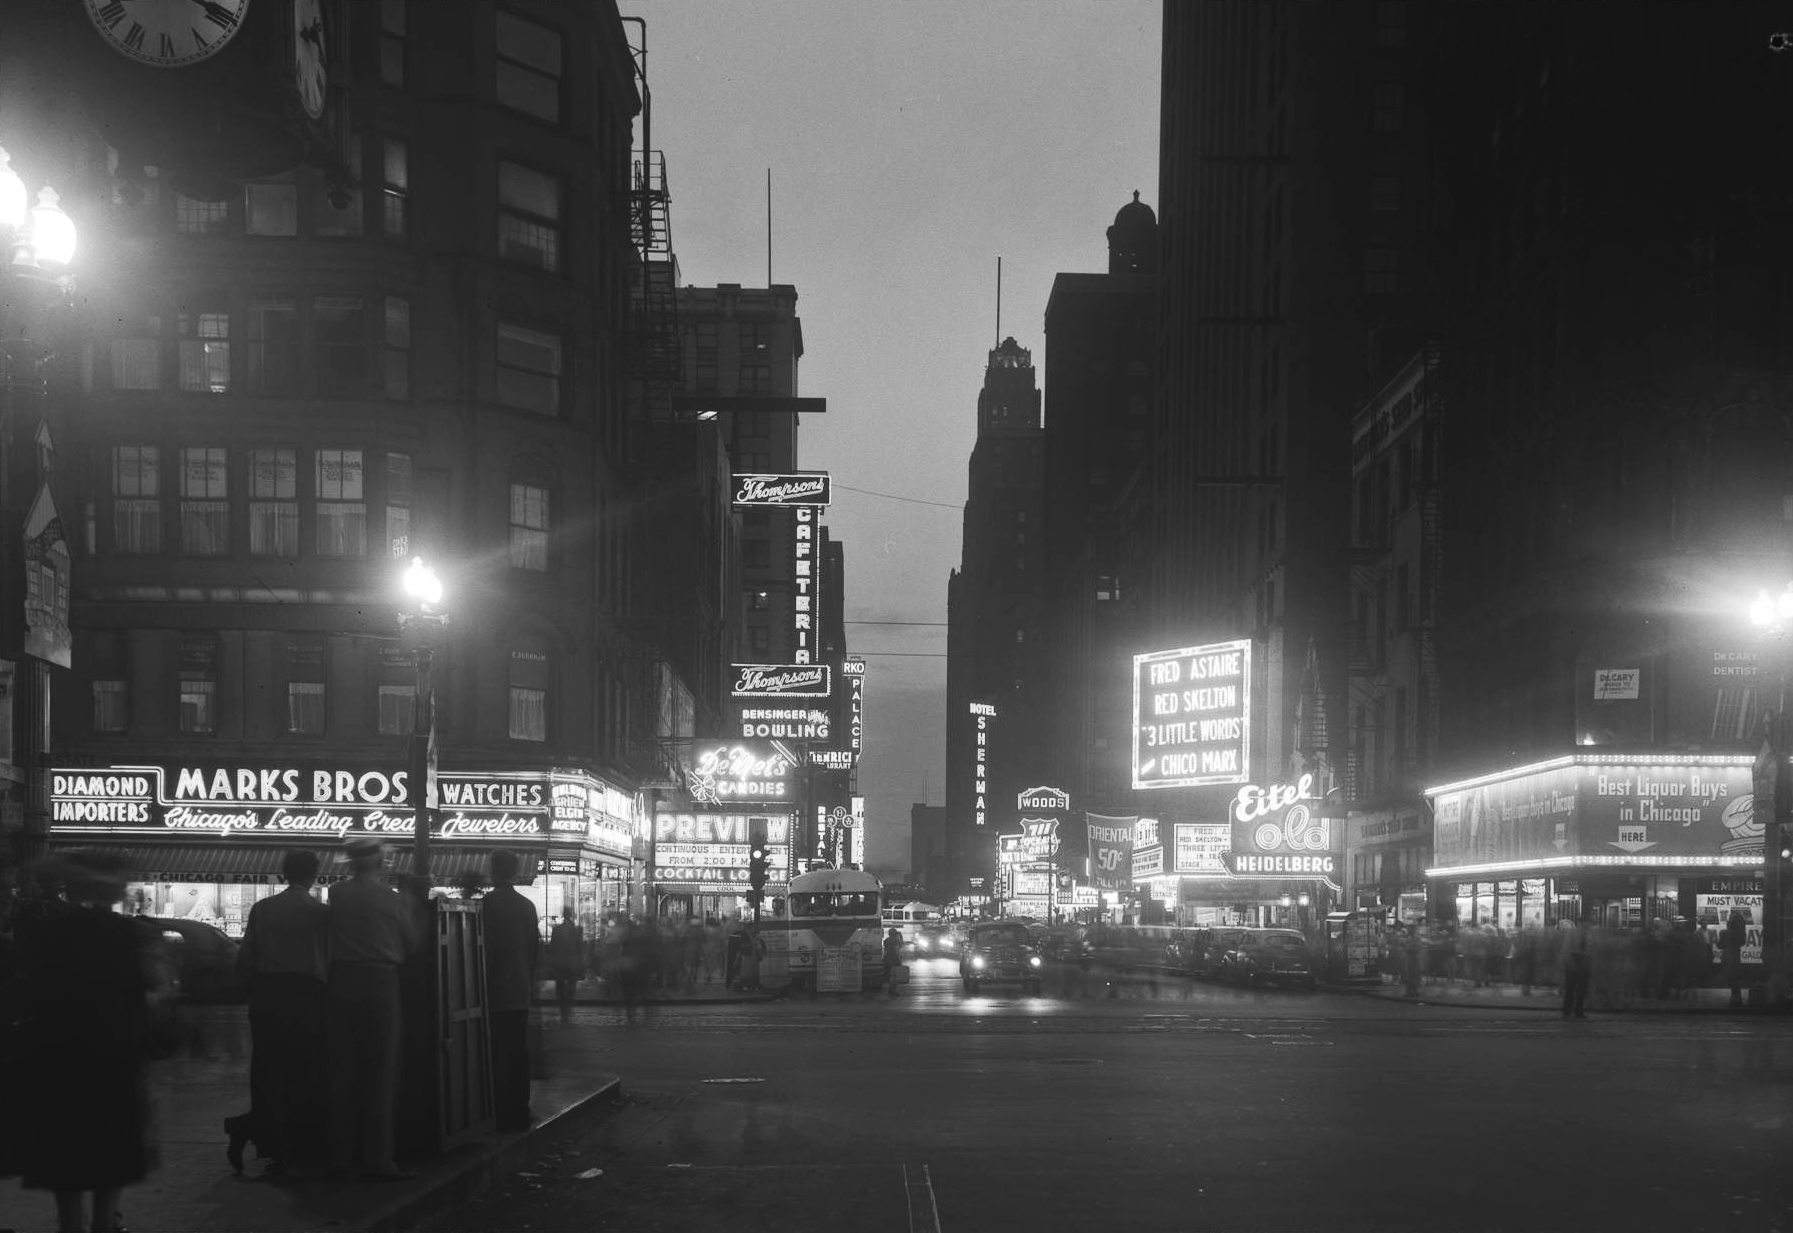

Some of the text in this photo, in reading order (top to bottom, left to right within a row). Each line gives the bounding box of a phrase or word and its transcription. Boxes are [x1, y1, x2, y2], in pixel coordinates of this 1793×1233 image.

[796, 508, 811, 664] CAFETERIA
[844, 662, 864, 673] RKO
[1150, 652, 1240, 685] FRED ASTAIRE
[969, 703, 996, 716] HOTEL
[1155, 685, 1235, 715] RED SKELTON
[852, 679, 861, 748] PALACE
[743, 723, 828, 738] BOWLING
[1159, 721, 1198, 746] LITTLE
[976, 716, 986, 825] SHERMAN
[1161, 749, 1237, 776] CHICO MARX
[54, 776, 149, 796] DIAMOND
[175, 768, 408, 803] MARKS BROS
[443, 783, 541, 805] WATCHES
[718, 781, 785, 795] CANDIES
[1636, 774, 1687, 800] Liquor
[1691, 774, 1728, 801] Buys
[1022, 798, 1065, 808] WOODS
[1236, 773, 1313, 822] Eitel
[54, 802, 149, 822] IMPORTERS
[1620, 802, 1633, 821] in
[164, 806, 414, 838] Chicago's Leading Cred
[441, 812, 539, 837] Jewelers
[656, 814, 789, 842] PREVIW
[1089, 825, 1135, 843] ORIENTAL
[1621, 832, 1645, 843] HERE
[656, 845, 788, 856] CONTINUOUS ENTERTENT
[669, 856, 694, 865] FROM
[655, 867, 787, 881] COCKTAIL LOGE
[1236, 856, 1333, 872] HEIDELBERG
[158, 871, 225, 883] CHICAGO
[233, 873, 270, 884] FAIR
[1712, 881, 1762, 891] EMPIRE
[1707, 896, 1763, 906] MUST VACAT
